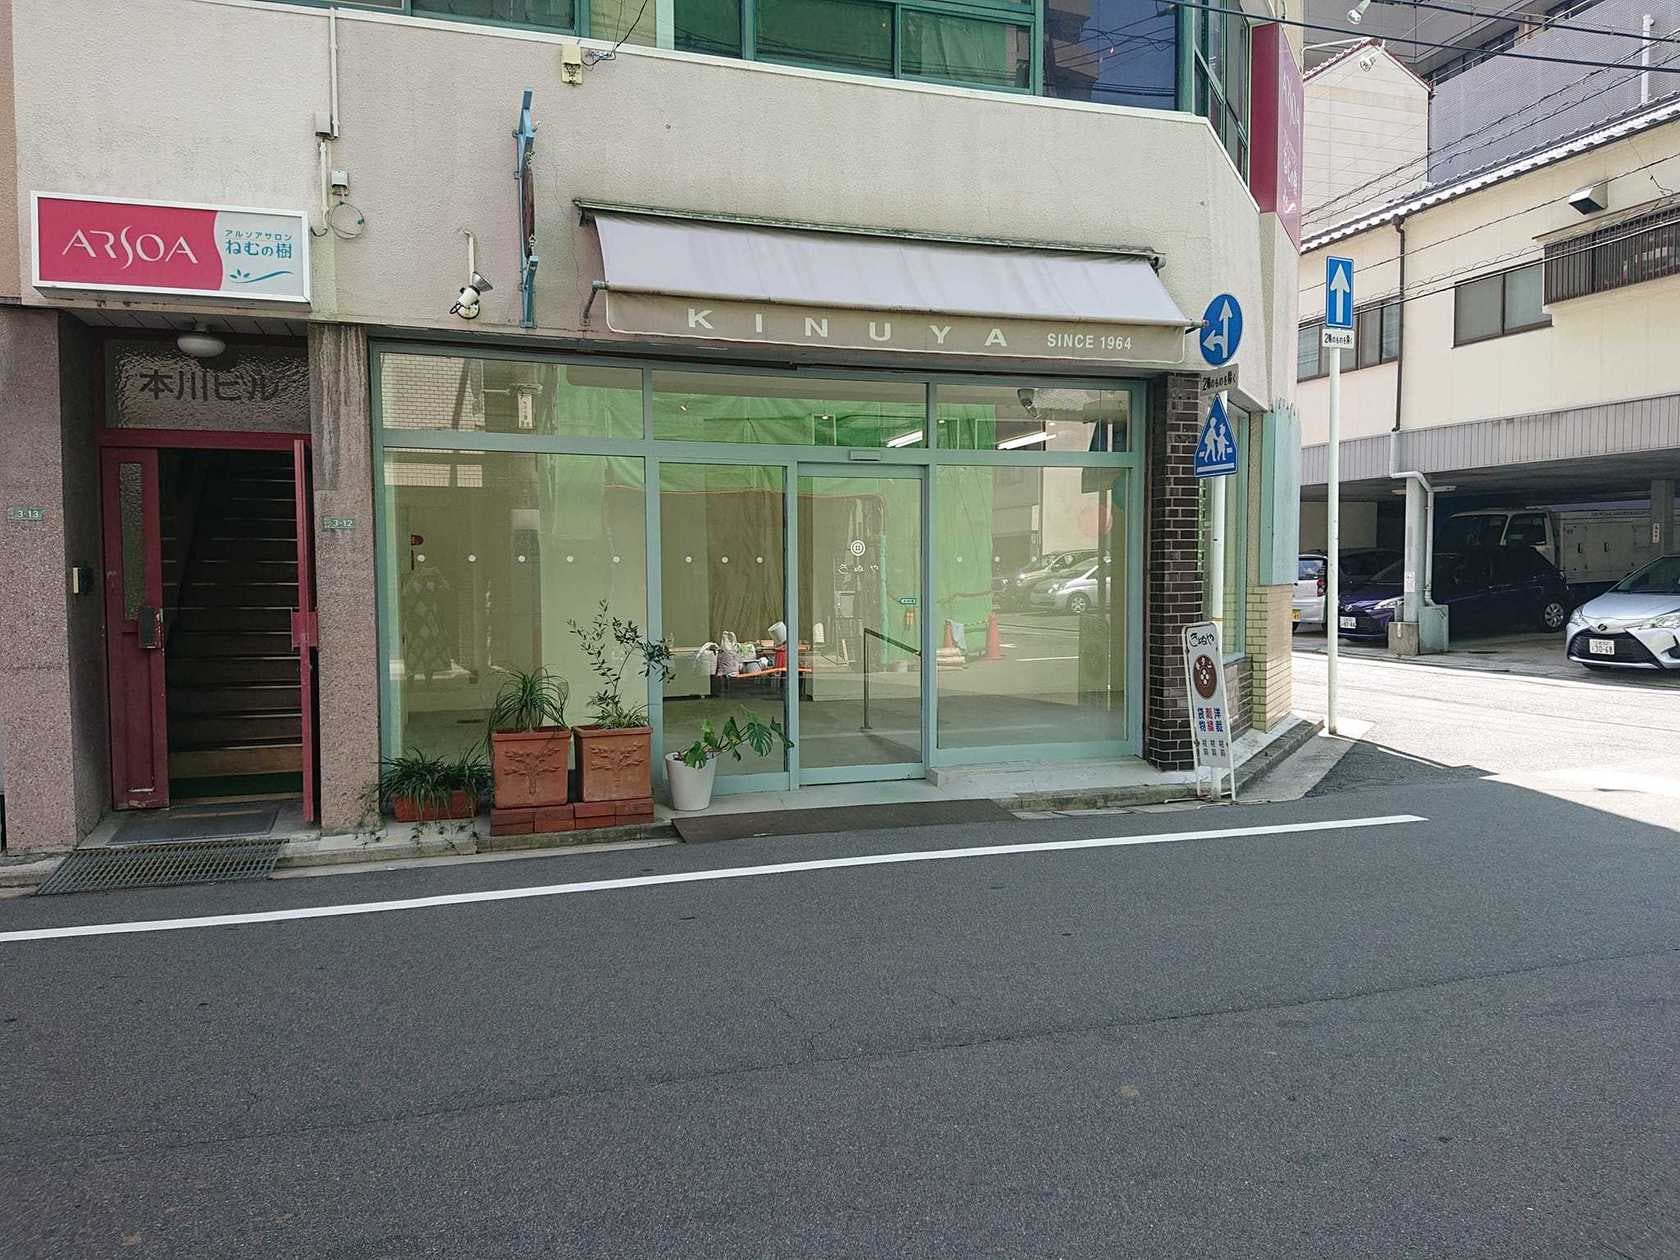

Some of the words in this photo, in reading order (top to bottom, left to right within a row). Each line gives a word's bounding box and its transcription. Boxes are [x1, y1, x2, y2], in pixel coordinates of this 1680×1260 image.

[62, 225, 199, 270] ARSOA
[225, 229, 292, 241] アルソアサロン
[225, 239, 292, 259] ねむの樹
[687, 308, 1008, 348] KINUYA
[1047, 333, 1094, 349] SINCE
[1099, 335, 1133, 350] 1964
[139, 368, 281, 401] 本川ビル
